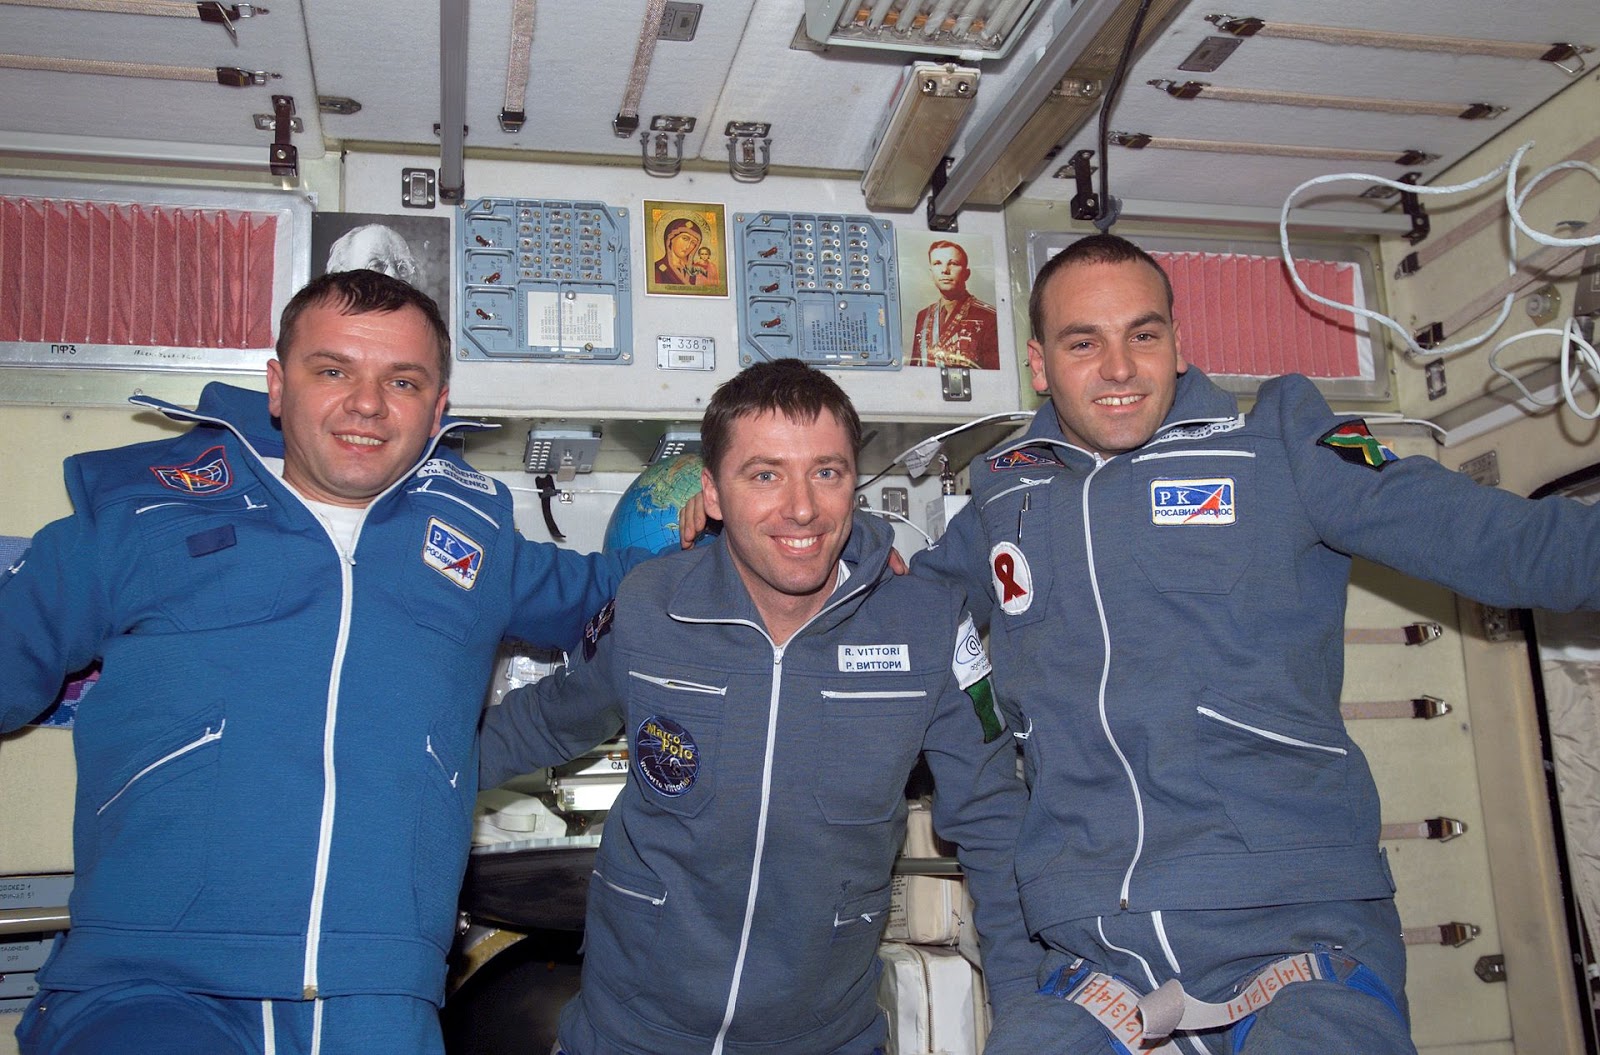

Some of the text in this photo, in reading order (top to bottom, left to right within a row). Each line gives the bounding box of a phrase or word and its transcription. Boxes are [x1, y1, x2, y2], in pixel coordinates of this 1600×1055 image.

[678, 339, 699, 349] 338
[845, 647, 900, 656] R. VITTORI
[856, 661, 902, 669] ВИТТОРИ
[647, 723, 680, 744] Marco
[661, 738, 693, 759] Polo
